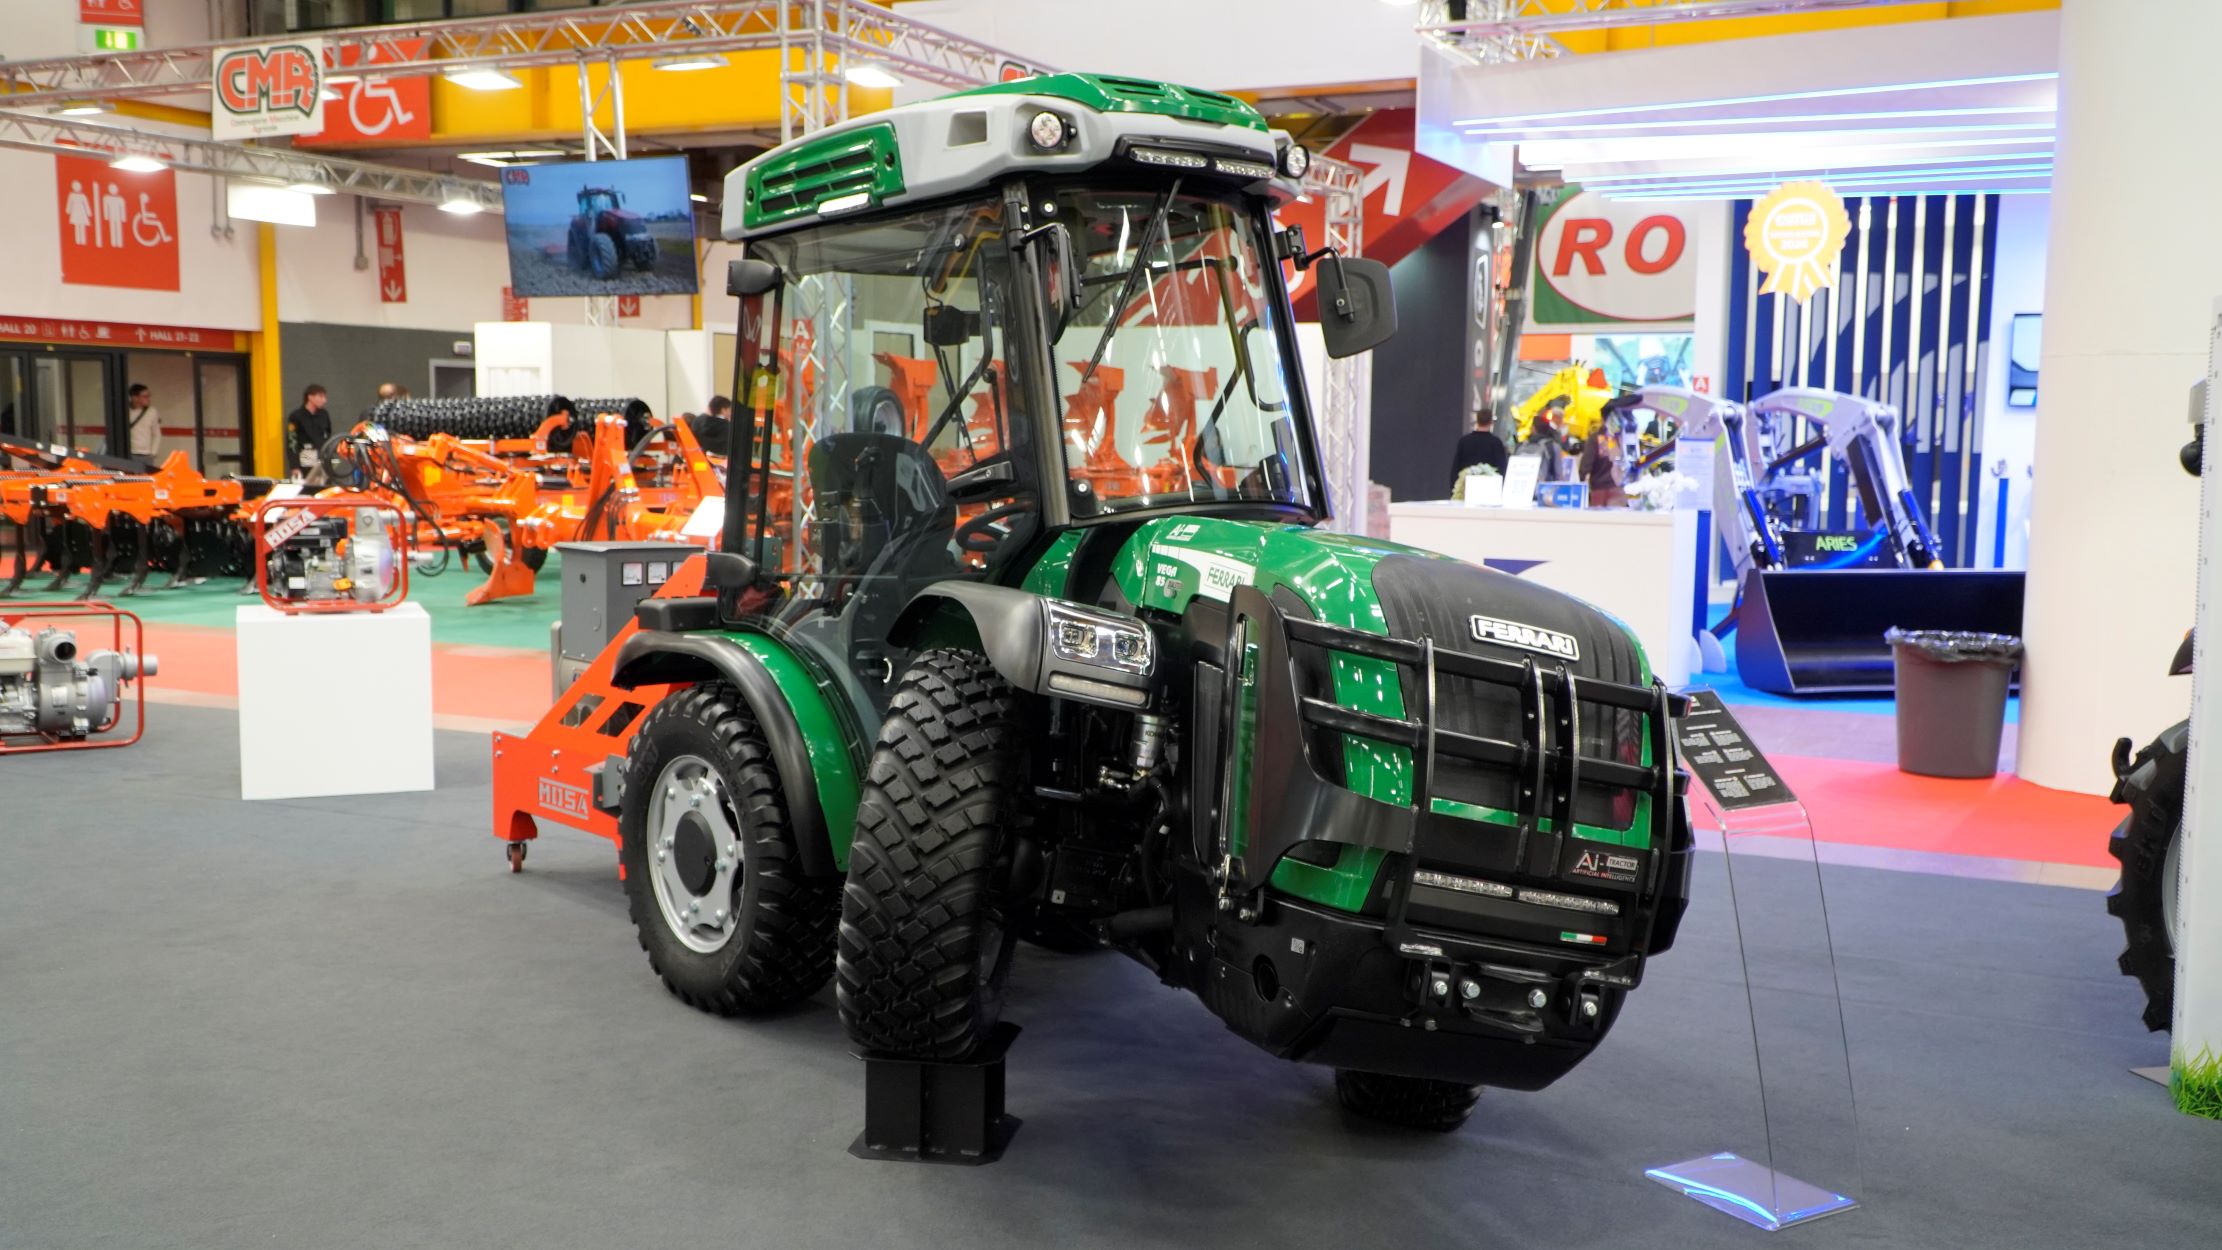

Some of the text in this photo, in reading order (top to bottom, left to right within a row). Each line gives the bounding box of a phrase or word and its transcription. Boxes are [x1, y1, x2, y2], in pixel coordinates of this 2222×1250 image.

[216, 45, 319, 118] CMA
[24, 323, 37, 335] 20
[1815, 535, 1858, 552] ARIES
[1157, 563, 1178, 577] VEGA
[1477, 618, 1575, 656] FERRARI
[538, 781, 589, 816] MOSA
[1609, 857, 1636, 868] TRACTOR
